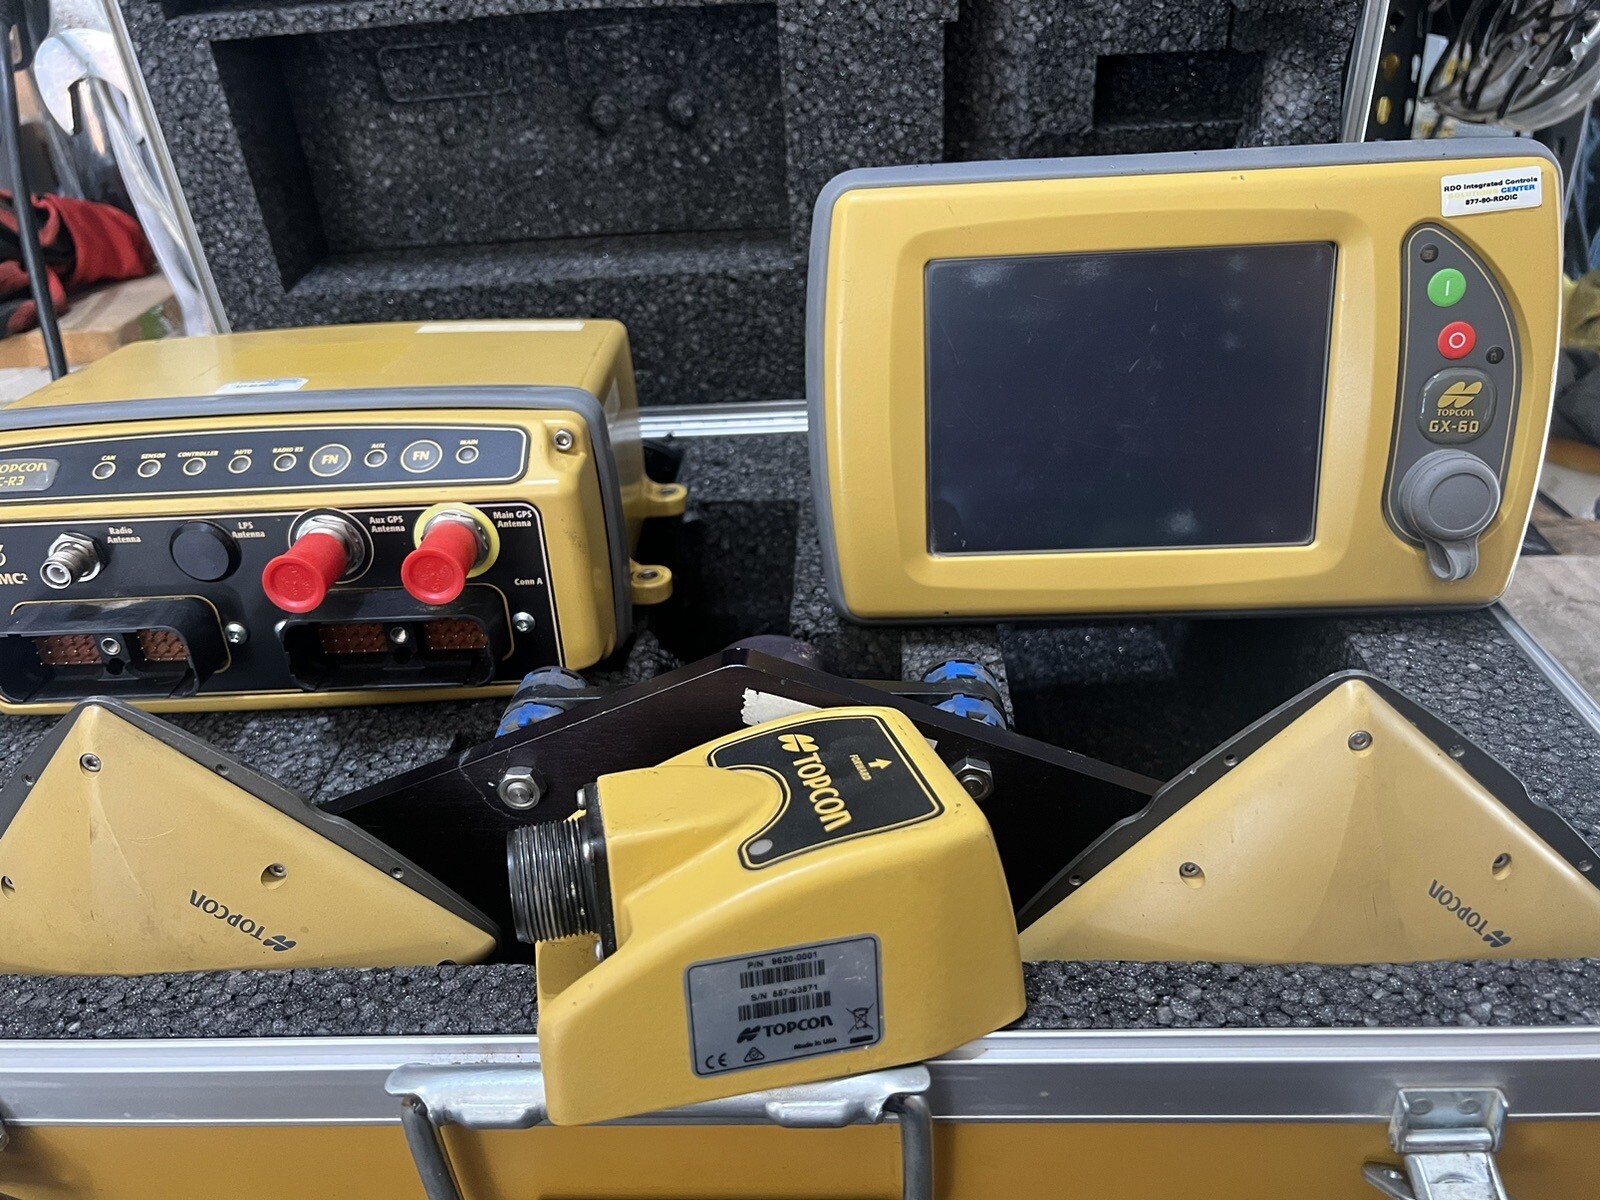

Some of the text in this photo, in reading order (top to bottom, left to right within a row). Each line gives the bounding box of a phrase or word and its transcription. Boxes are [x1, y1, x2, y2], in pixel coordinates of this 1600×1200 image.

[1444, 176, 1538, 192] RDO Integrated Controls
[1500, 184, 1536, 194] CENTER
[1465, 194, 1518, 206] 877-90-RDOIC
[1436, 408, 1474, 417] TOPCON
[1428, 420, 1480, 434] GX-60
[177, 450, 219, 458] CONTROLLER
[272, 446, 294, 454] RADIO
[321, 454, 340, 465] FN
[412, 450, 430, 461] FN
[0, 462, 48, 473] OPCON
[493, 510, 532, 519] Main GPS
[370, 515, 404, 524] Aux GPS
[498, 520, 532, 528] Antenna
[238, 521, 254, 530] LPS
[372, 525, 406, 533] Antenna
[108, 526, 133, 535] Radio
[232, 530, 265, 538] Antenna
[107, 535, 141, 544] Antenna
[514, 578, 535, 586] Conn
[850, 754, 872, 780] FORWARD
[792, 752, 852, 832] TOPCON
[1428, 880, 1488, 936] TOPCON
[190, 890, 265, 940] TOPCON
[747, 952, 818, 969] P/N 9620-0001
[750, 992, 767, 1001] S/N
[763, 1015, 833, 1038] TOPCON
